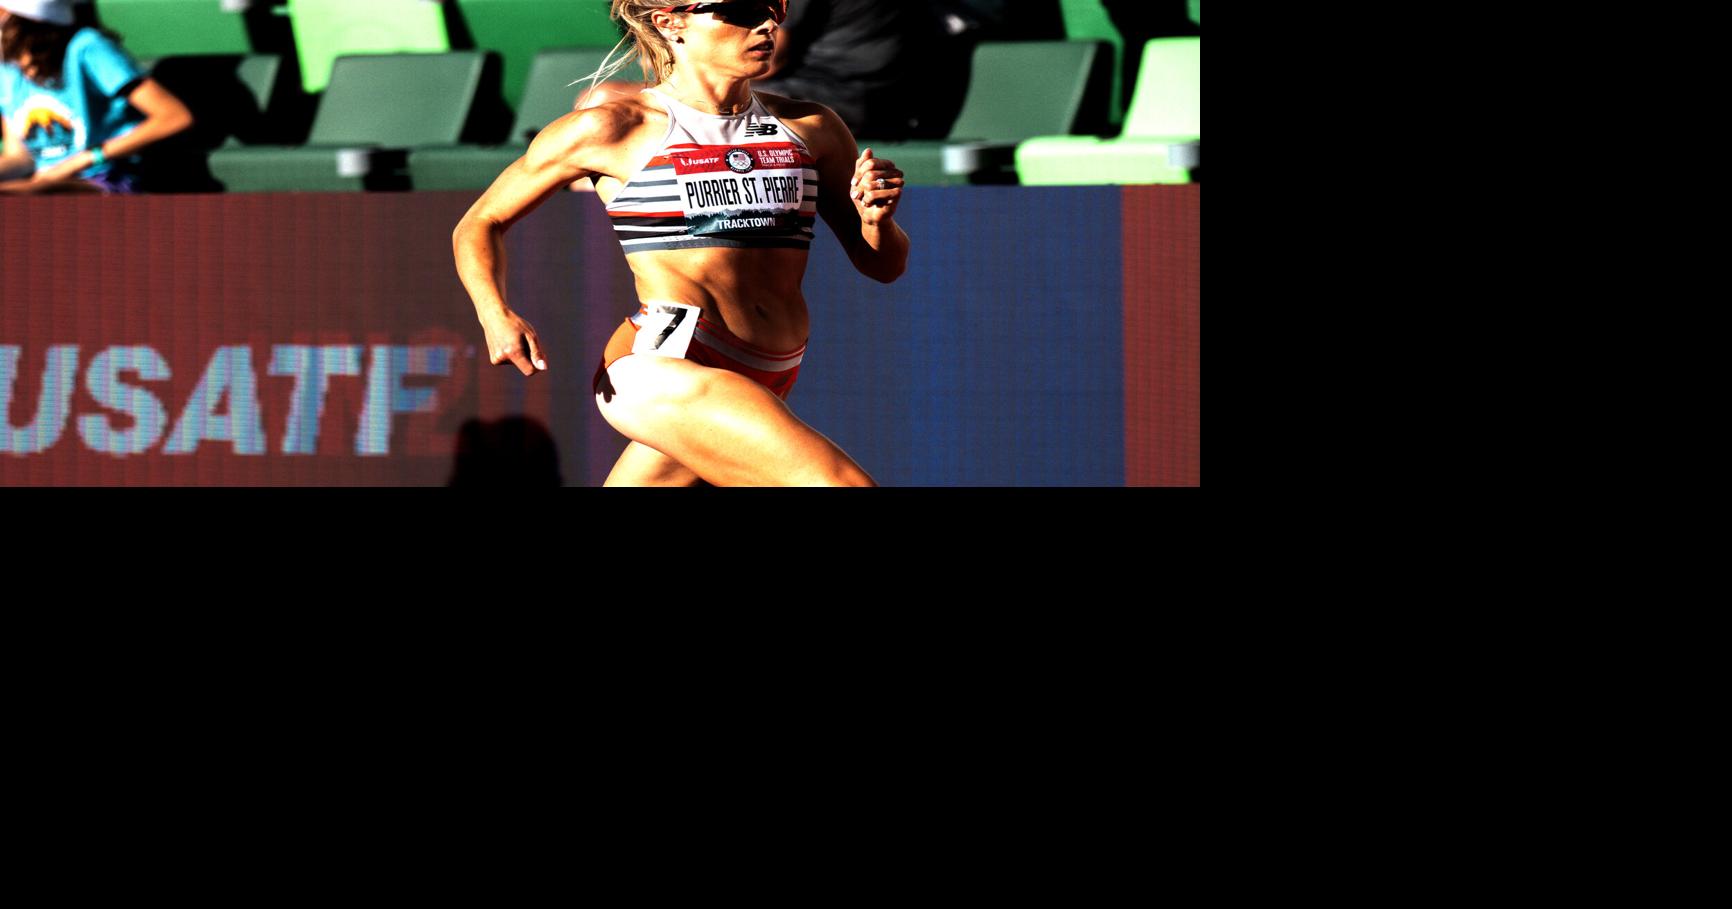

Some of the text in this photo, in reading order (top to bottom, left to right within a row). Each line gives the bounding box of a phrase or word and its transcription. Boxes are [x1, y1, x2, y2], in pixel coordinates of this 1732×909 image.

[693, 157, 719, 165] USATF
[760, 155, 795, 164] TEAM TRIALS
[769, 149, 793, 157] OLYMPIC
[685, 175, 799, 209] PURRIER ST. PIERRE
[656, 305, 688, 350] 7
[0, 344, 454, 455] USATF
